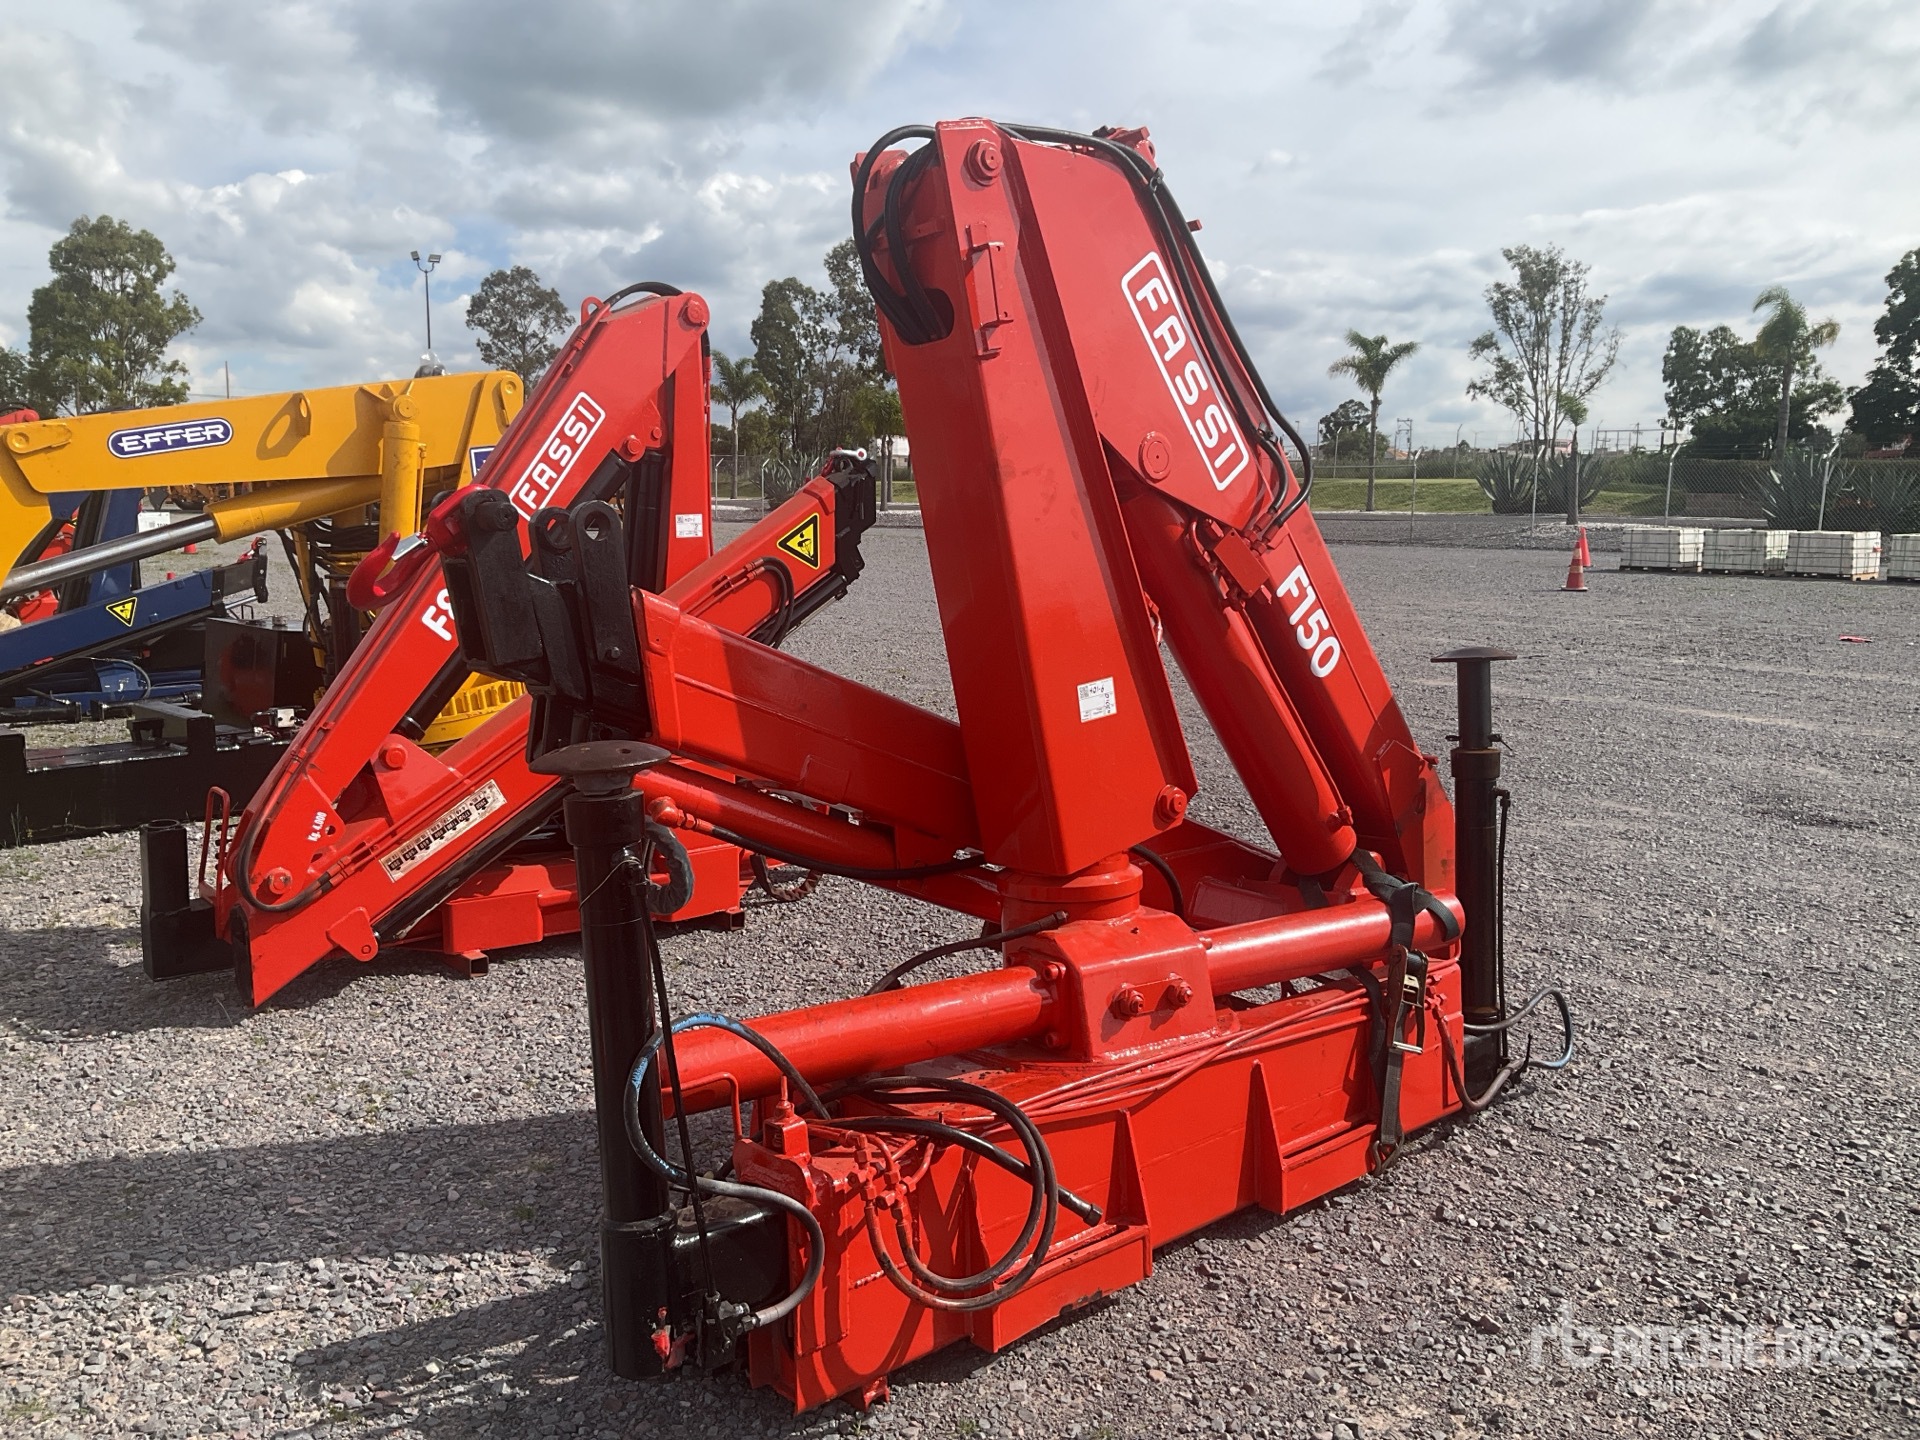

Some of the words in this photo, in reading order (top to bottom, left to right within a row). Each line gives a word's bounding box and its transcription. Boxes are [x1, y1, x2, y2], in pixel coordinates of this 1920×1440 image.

[1136, 277, 1238, 469] FASSI
[117, 424, 225, 452] EFFER
[518, 404, 596, 510] FASSI
[1276, 564, 1341, 679] F150
